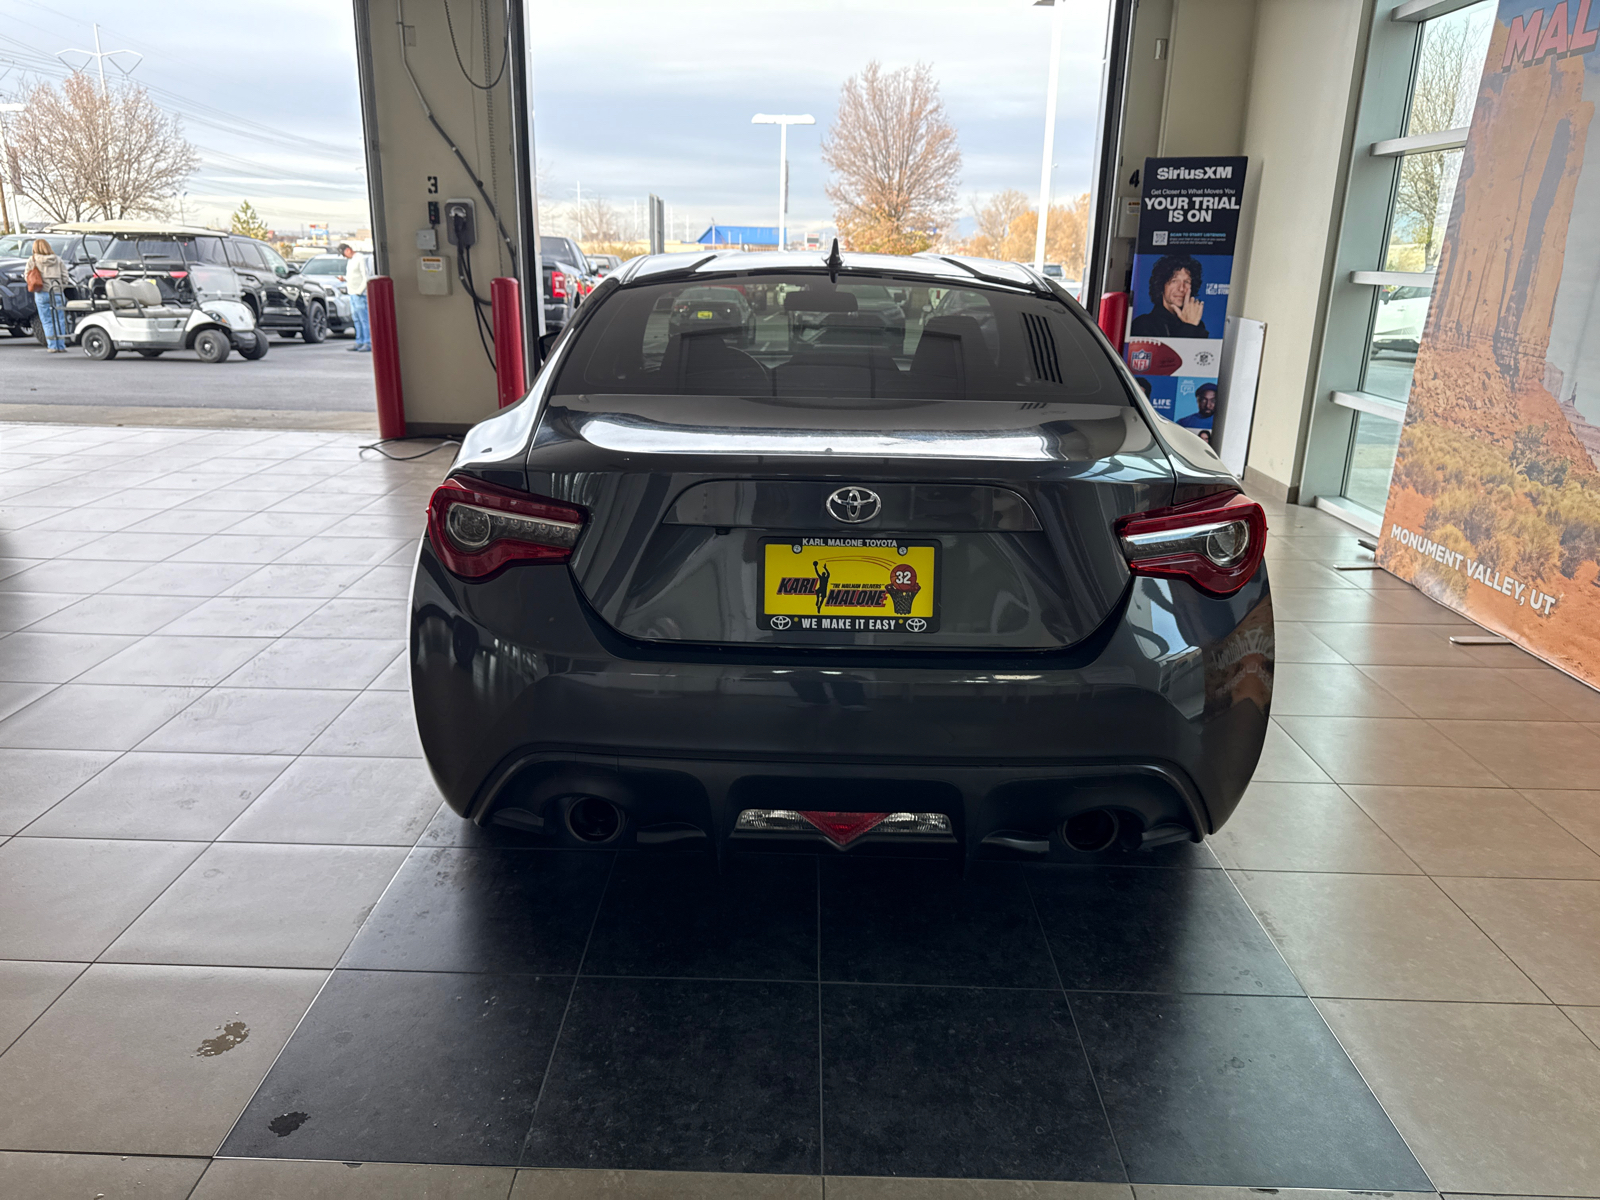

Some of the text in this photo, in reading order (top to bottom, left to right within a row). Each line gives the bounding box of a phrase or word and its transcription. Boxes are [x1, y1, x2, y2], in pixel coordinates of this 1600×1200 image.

[1129, 169, 1140, 188] 4
[1156, 166, 1233, 180] SiriusXM
[427, 176, 438, 194] 3
[1144, 197, 1189, 210] YOUR
[1192, 197, 1240, 209] TRIAL
[1168, 210, 1212, 222] IS ON
[1132, 359, 1149, 370] NFL
[1153, 398, 1171, 406] LIFE
[802, 538, 898, 547] KARL MALONE TOYOTA
[1390, 523, 1556, 615] MONUMENT VALLEY, UT
[895, 571, 912, 584] 32
[777, 577, 817, 595] KARL
[825, 589, 888, 607] MALONE
[801, 618, 896, 630] WE MAKE IT EASY
